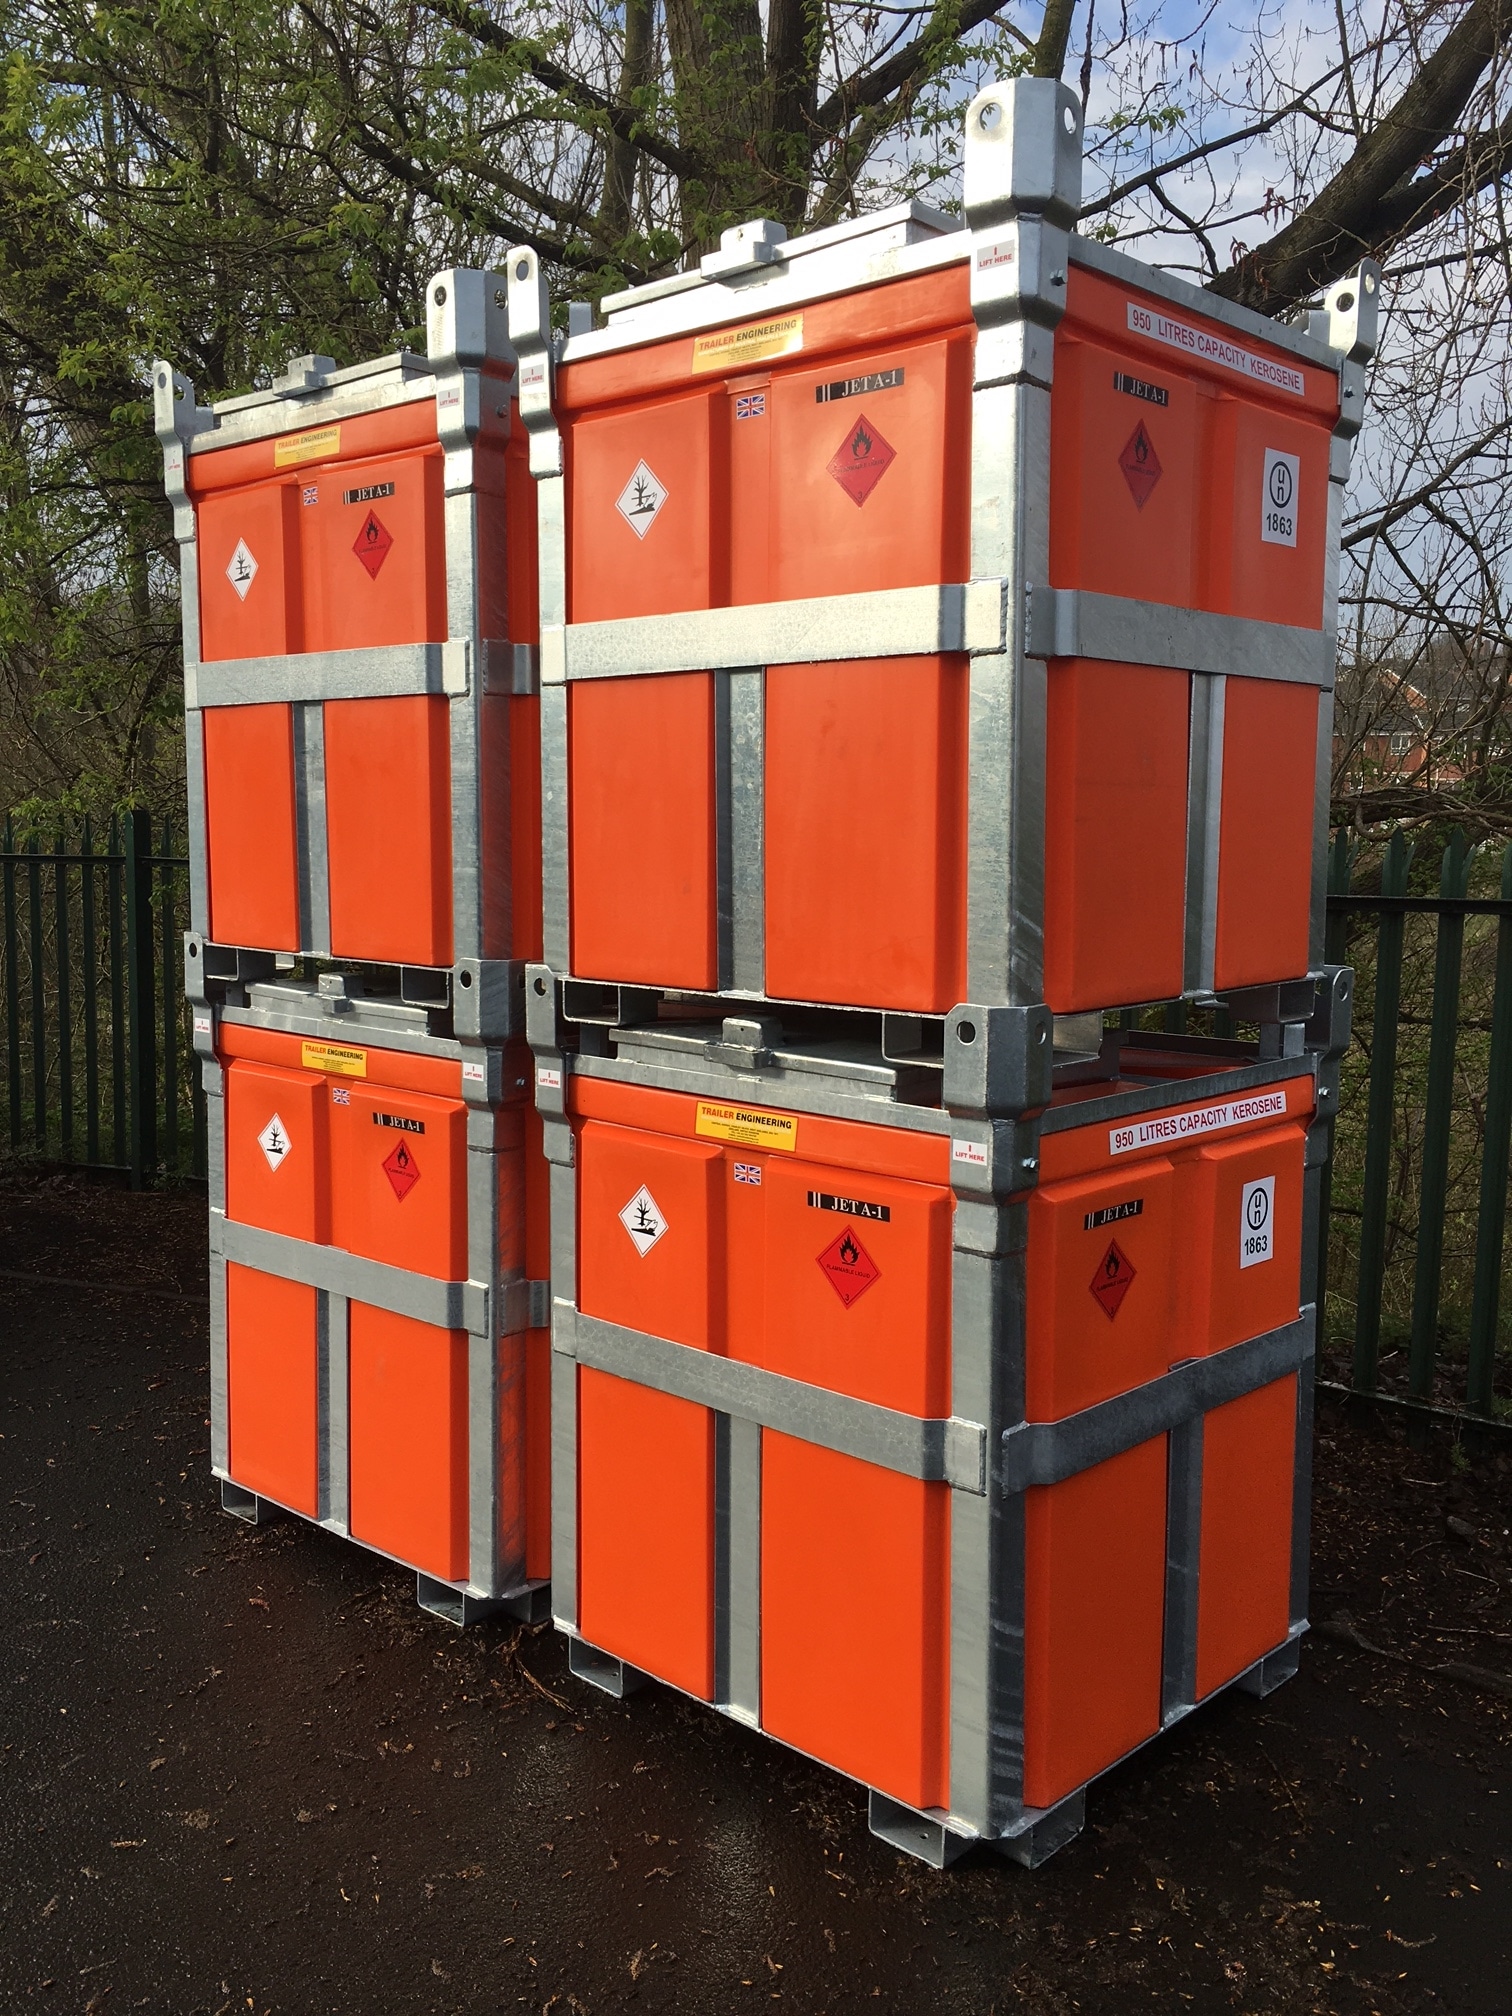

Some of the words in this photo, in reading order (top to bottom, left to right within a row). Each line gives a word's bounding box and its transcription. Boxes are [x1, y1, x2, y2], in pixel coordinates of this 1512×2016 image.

[979, 258, 993, 267] LIFT
[994, 253, 1012, 264] HERE
[699, 335, 734, 350] TRAILER
[736, 319, 797, 341] ENGINEERING
[1132, 309, 1151, 332] 950
[1158, 319, 1195, 348] LITRES
[1197, 335, 1246, 368] CAPACITY
[1250, 359, 1301, 391] KEROSENE
[841, 376, 872, 397] JET
[874, 370, 897, 389] A-1
[1130, 379, 1150, 398] JET
[1151, 386, 1166, 404] A-1
[278, 439, 300, 449] TRAILER
[300, 429, 337, 444] ENGINEERING
[356, 486, 375, 502] JET
[375, 484, 390, 497] A-1
[1266, 512, 1293, 537] 1863
[305, 1044, 327, 1054] TRAILER
[327, 1048, 364, 1060] ENGINEERING
[389, 1116, 406, 1129] JET
[407, 1119, 420, 1132] A-1
[701, 1106, 734, 1120] TRAILER
[736, 1112, 792, 1129] ENGINEERING
[1115, 1130, 1134, 1149] 950
[1139, 1119, 1177, 1142] LITRES
[1179, 1107, 1228, 1132] CAPACITY
[1232, 1095, 1283, 1120] KEROSENE
[955, 1151, 967, 1159] LIFT
[968, 1153, 985, 1162] HERE
[831, 1196, 859, 1214] JET
[861, 1203, 883, 1219] A-1
[1100, 1205, 1121, 1223] JET
[1122, 1200, 1138, 1217] A-1
[1244, 1234, 1268, 1256] 1863
[845, 1293, 850, 1301] 3
